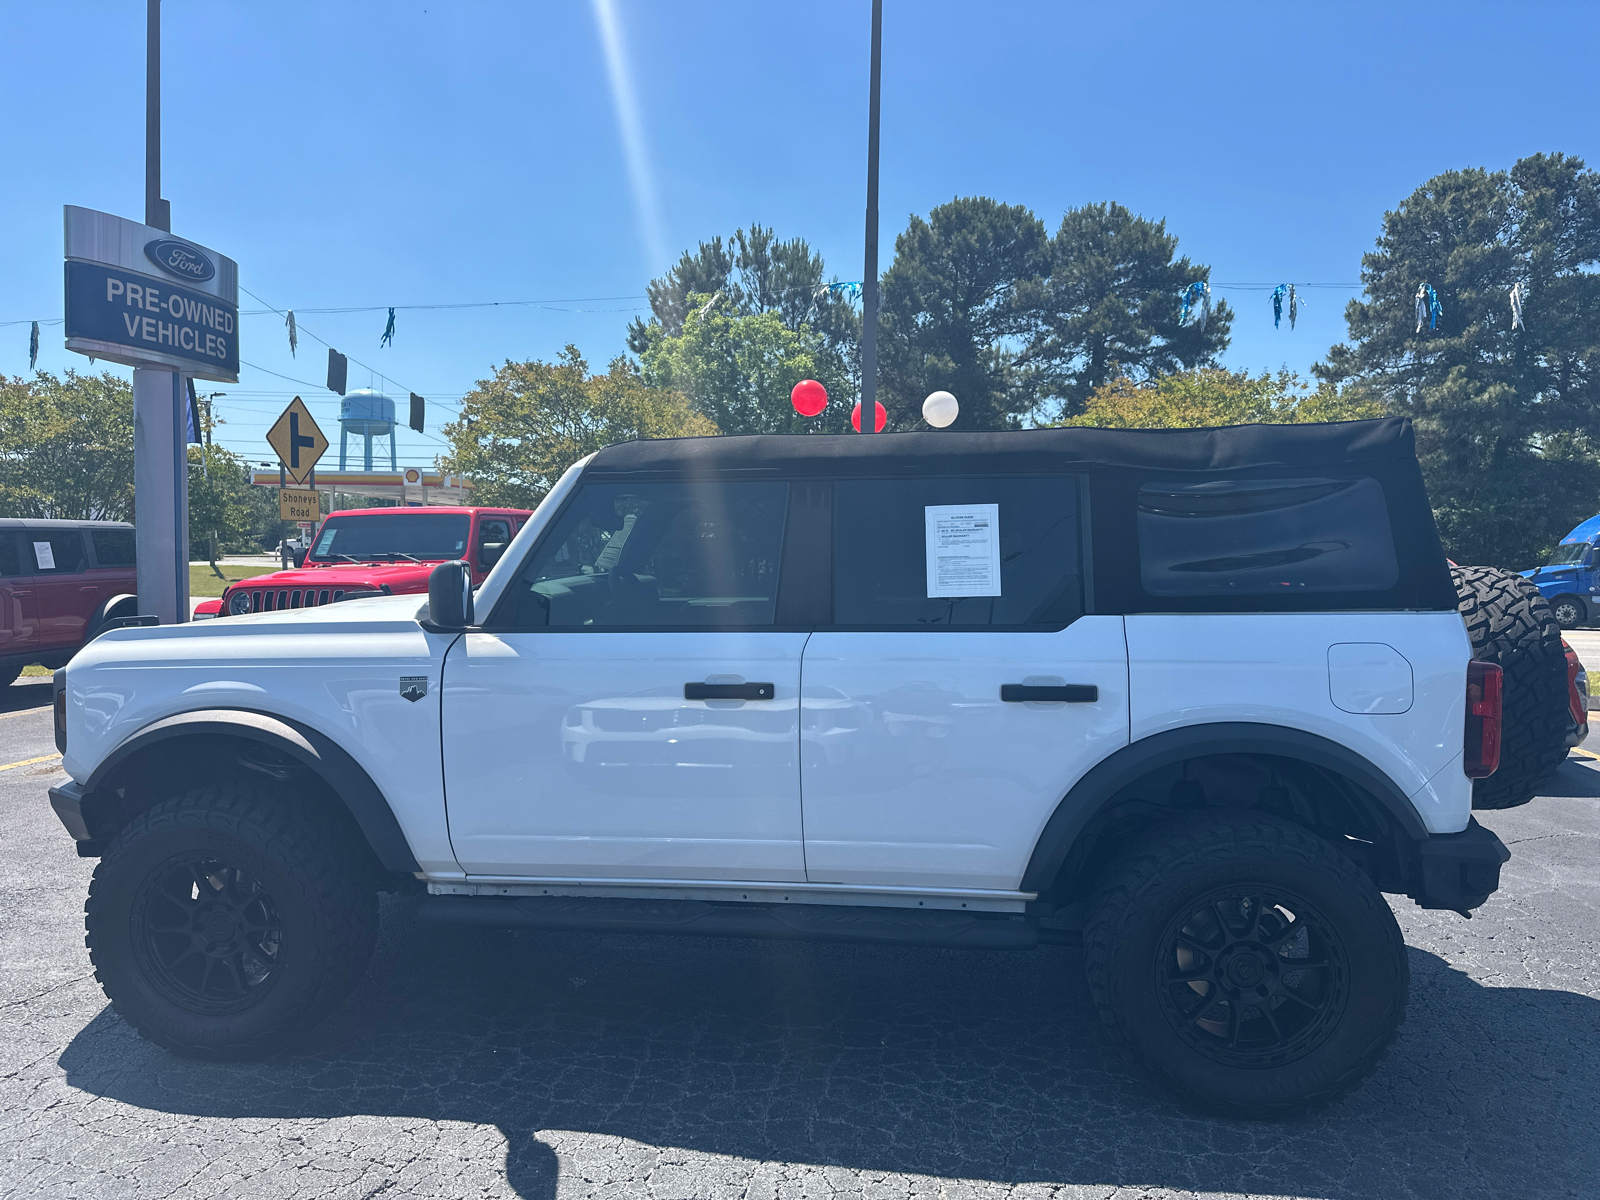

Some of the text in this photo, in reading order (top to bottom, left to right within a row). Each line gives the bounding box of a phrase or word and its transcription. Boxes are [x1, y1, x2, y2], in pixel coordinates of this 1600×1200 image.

[168, 249, 204, 275] Ford
[106, 277, 233, 335] PRE-OWNED
[123, 312, 227, 360] VEHICLES
[283, 492, 317, 505] Shoneys
[290, 507, 310, 518] Road
